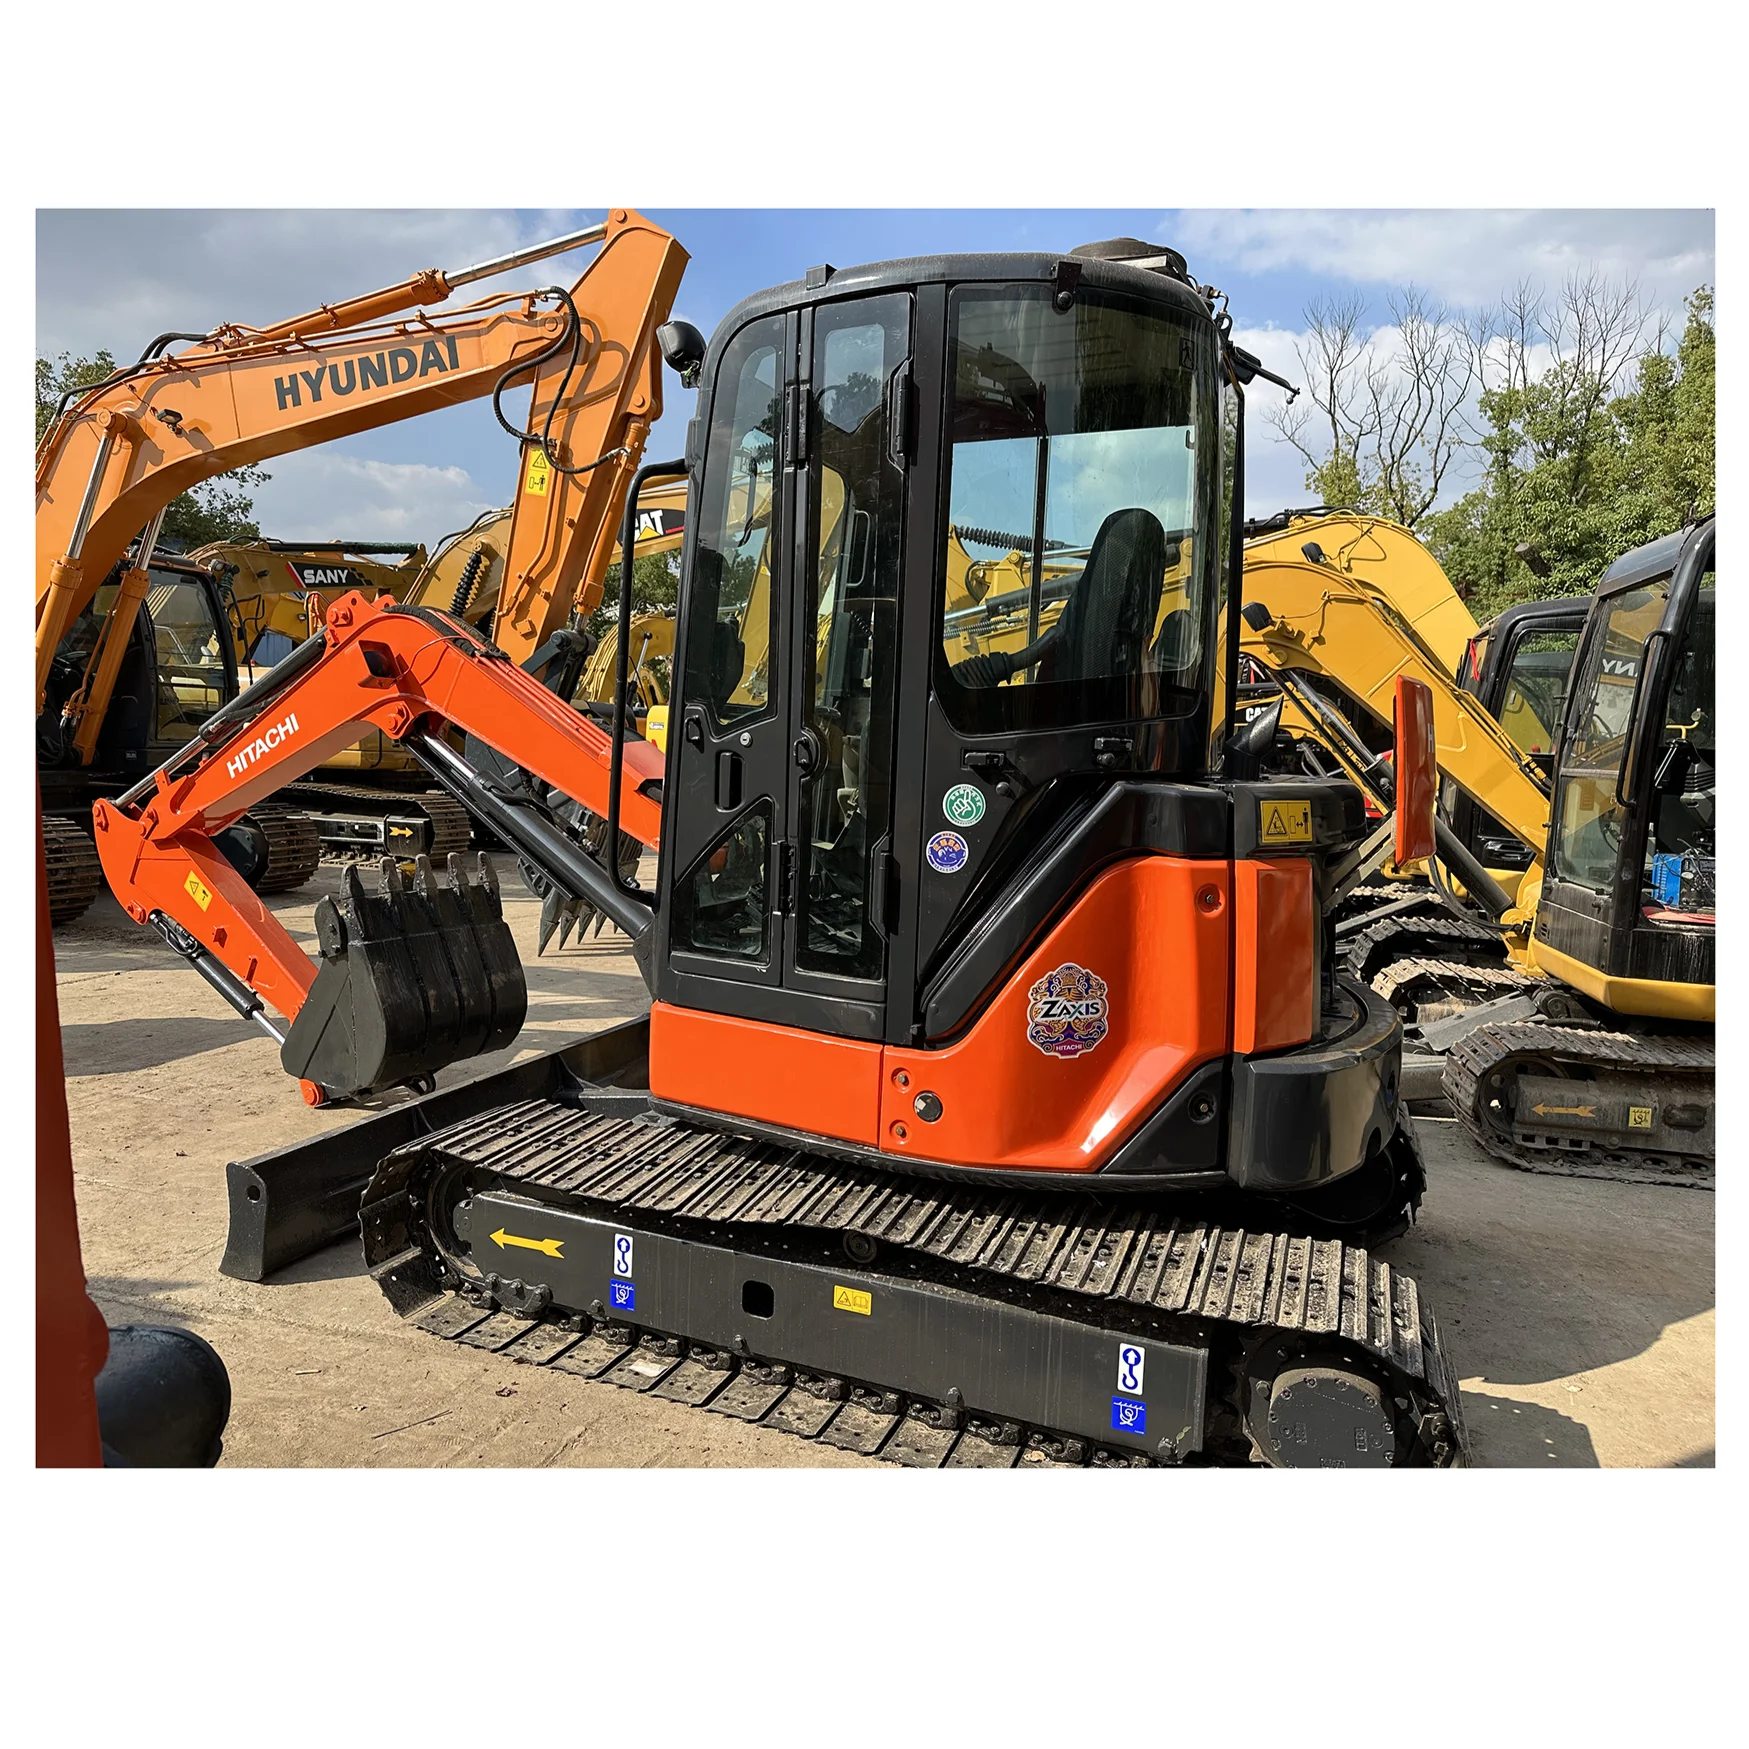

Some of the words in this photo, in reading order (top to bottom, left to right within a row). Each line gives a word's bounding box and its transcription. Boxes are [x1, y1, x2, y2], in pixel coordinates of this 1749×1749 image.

[274, 335, 460, 411] HYUNDAI
[303, 569, 349, 584] SANY
[226, 712, 300, 779] HITACHI
[1055, 1043, 1083, 1052] HITACHI
